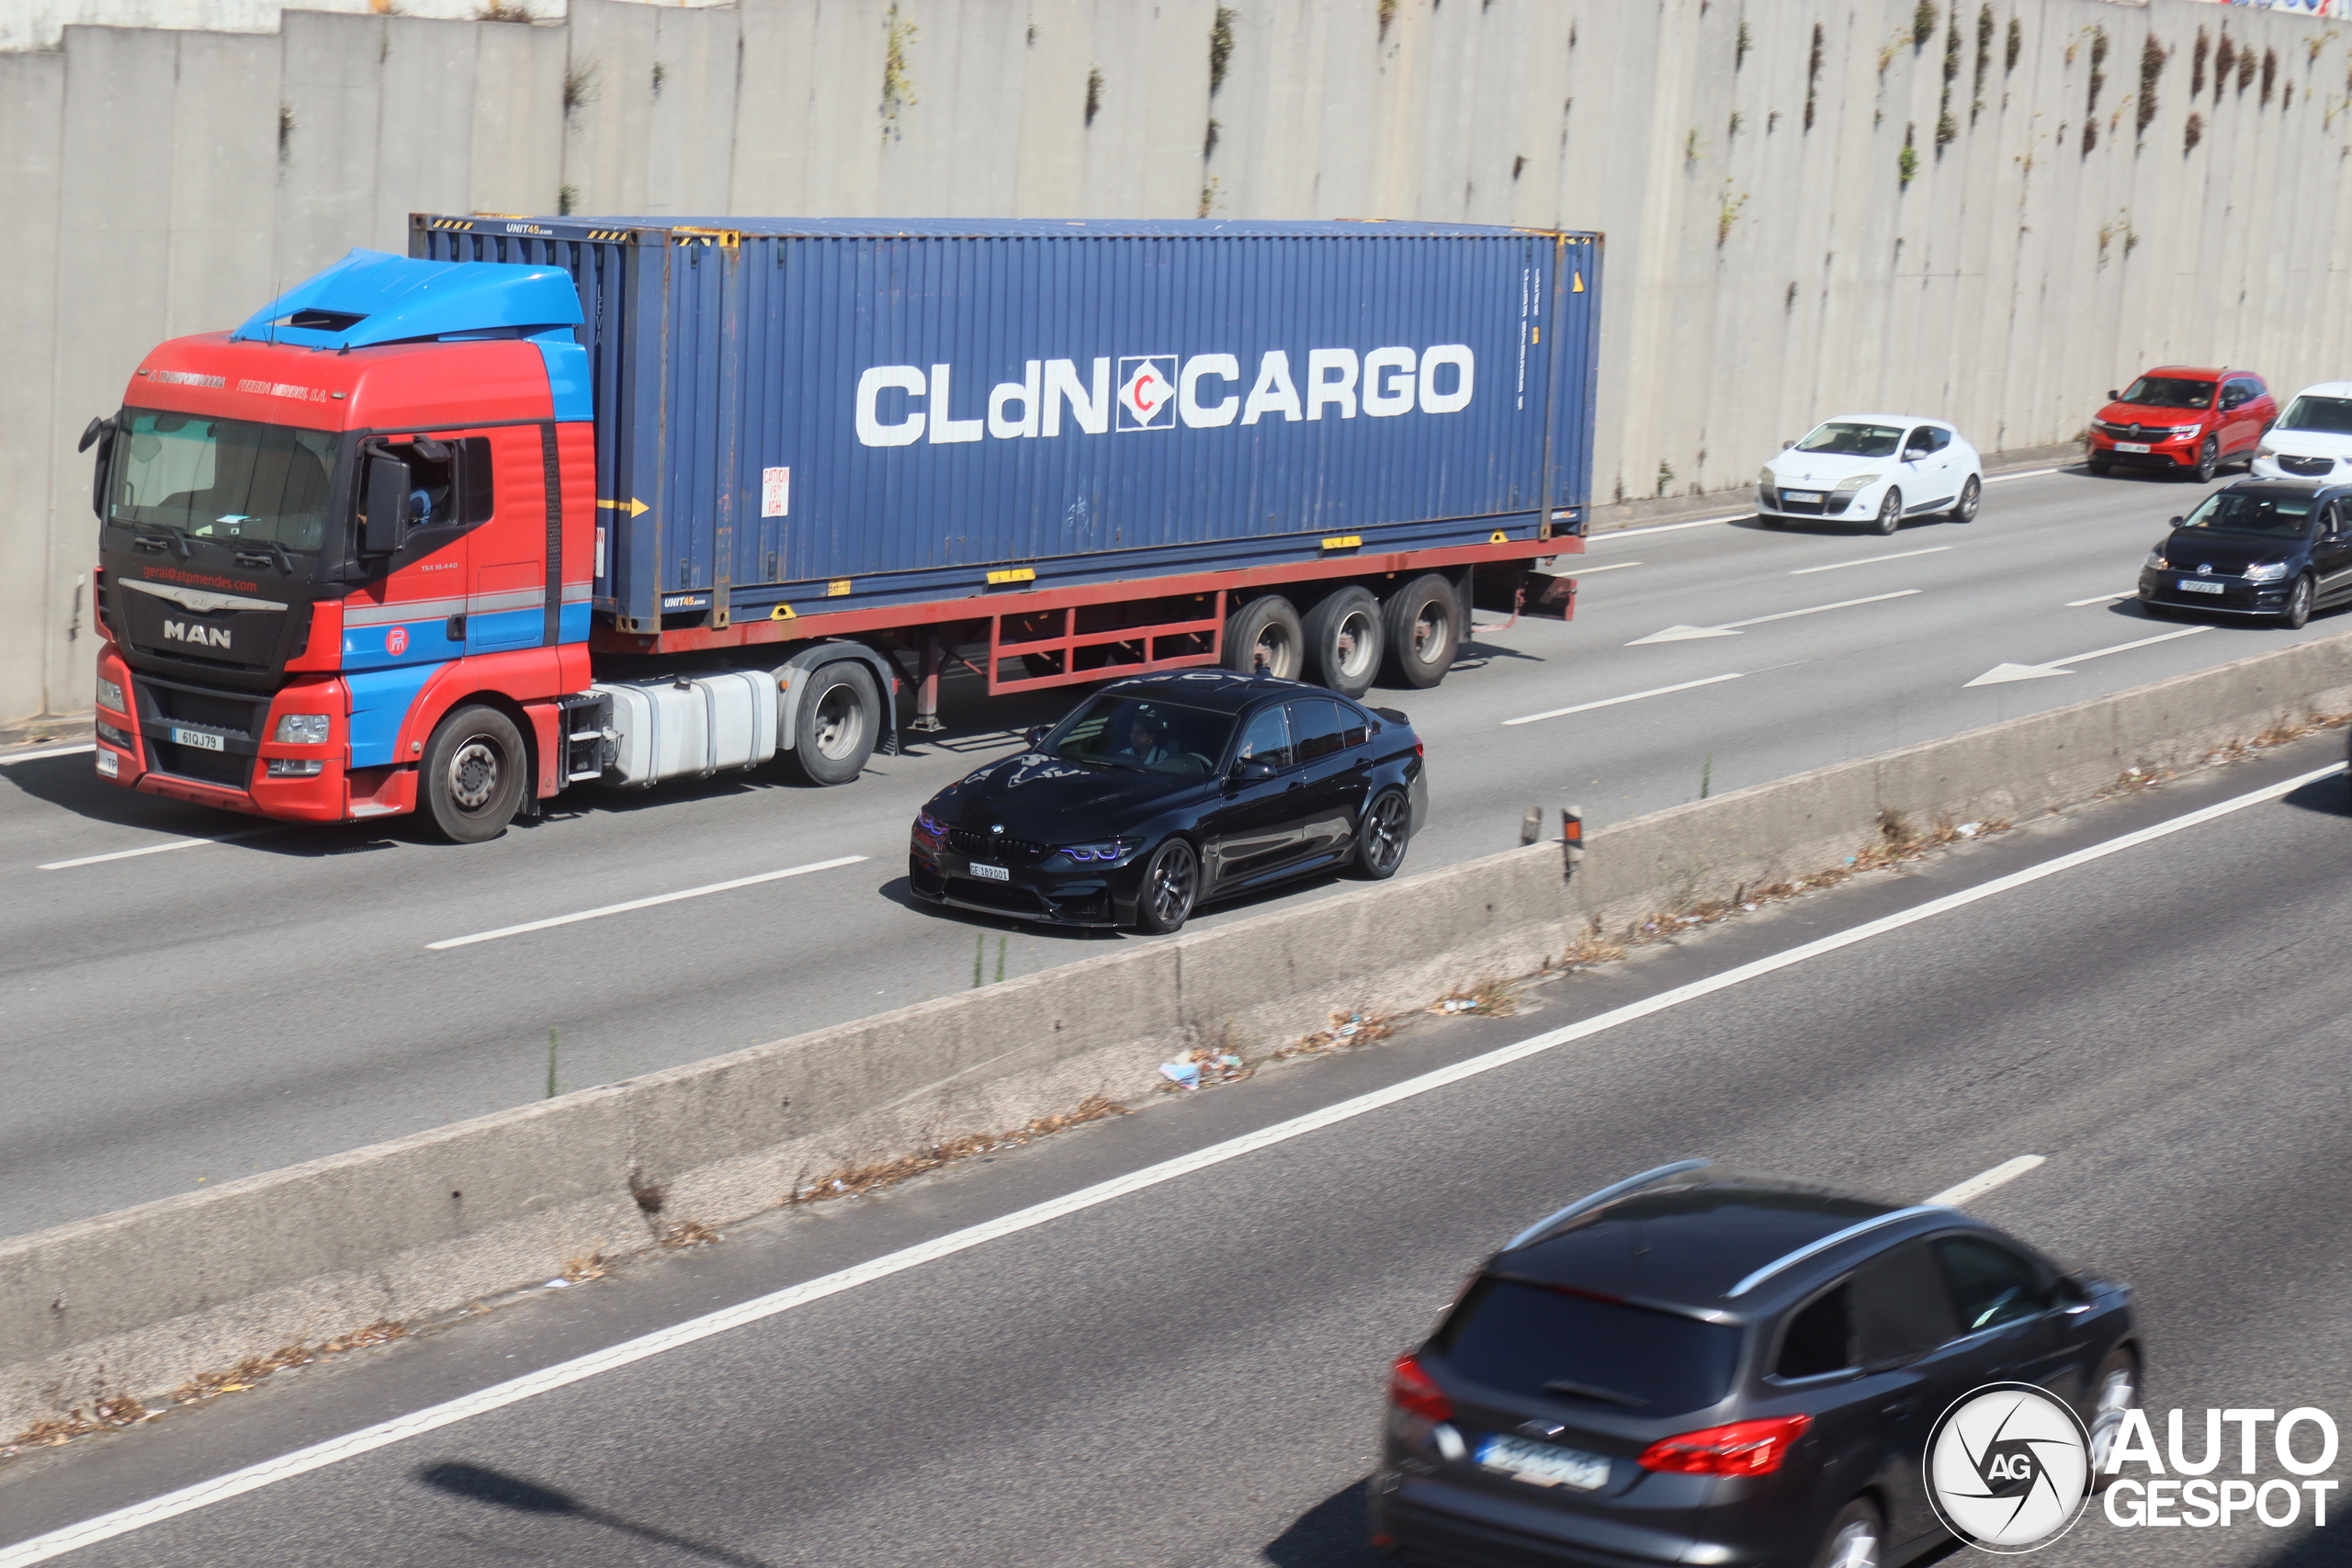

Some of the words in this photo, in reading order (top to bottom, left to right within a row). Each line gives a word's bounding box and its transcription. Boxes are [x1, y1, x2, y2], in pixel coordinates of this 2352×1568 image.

[855, 356, 1111, 447] CLdN
[1179, 344, 1475, 429] CARGO
[164, 619, 232, 649] MAN
[183, 732, 216, 748] 61QJ79
[107, 758, 117, 769] TP
